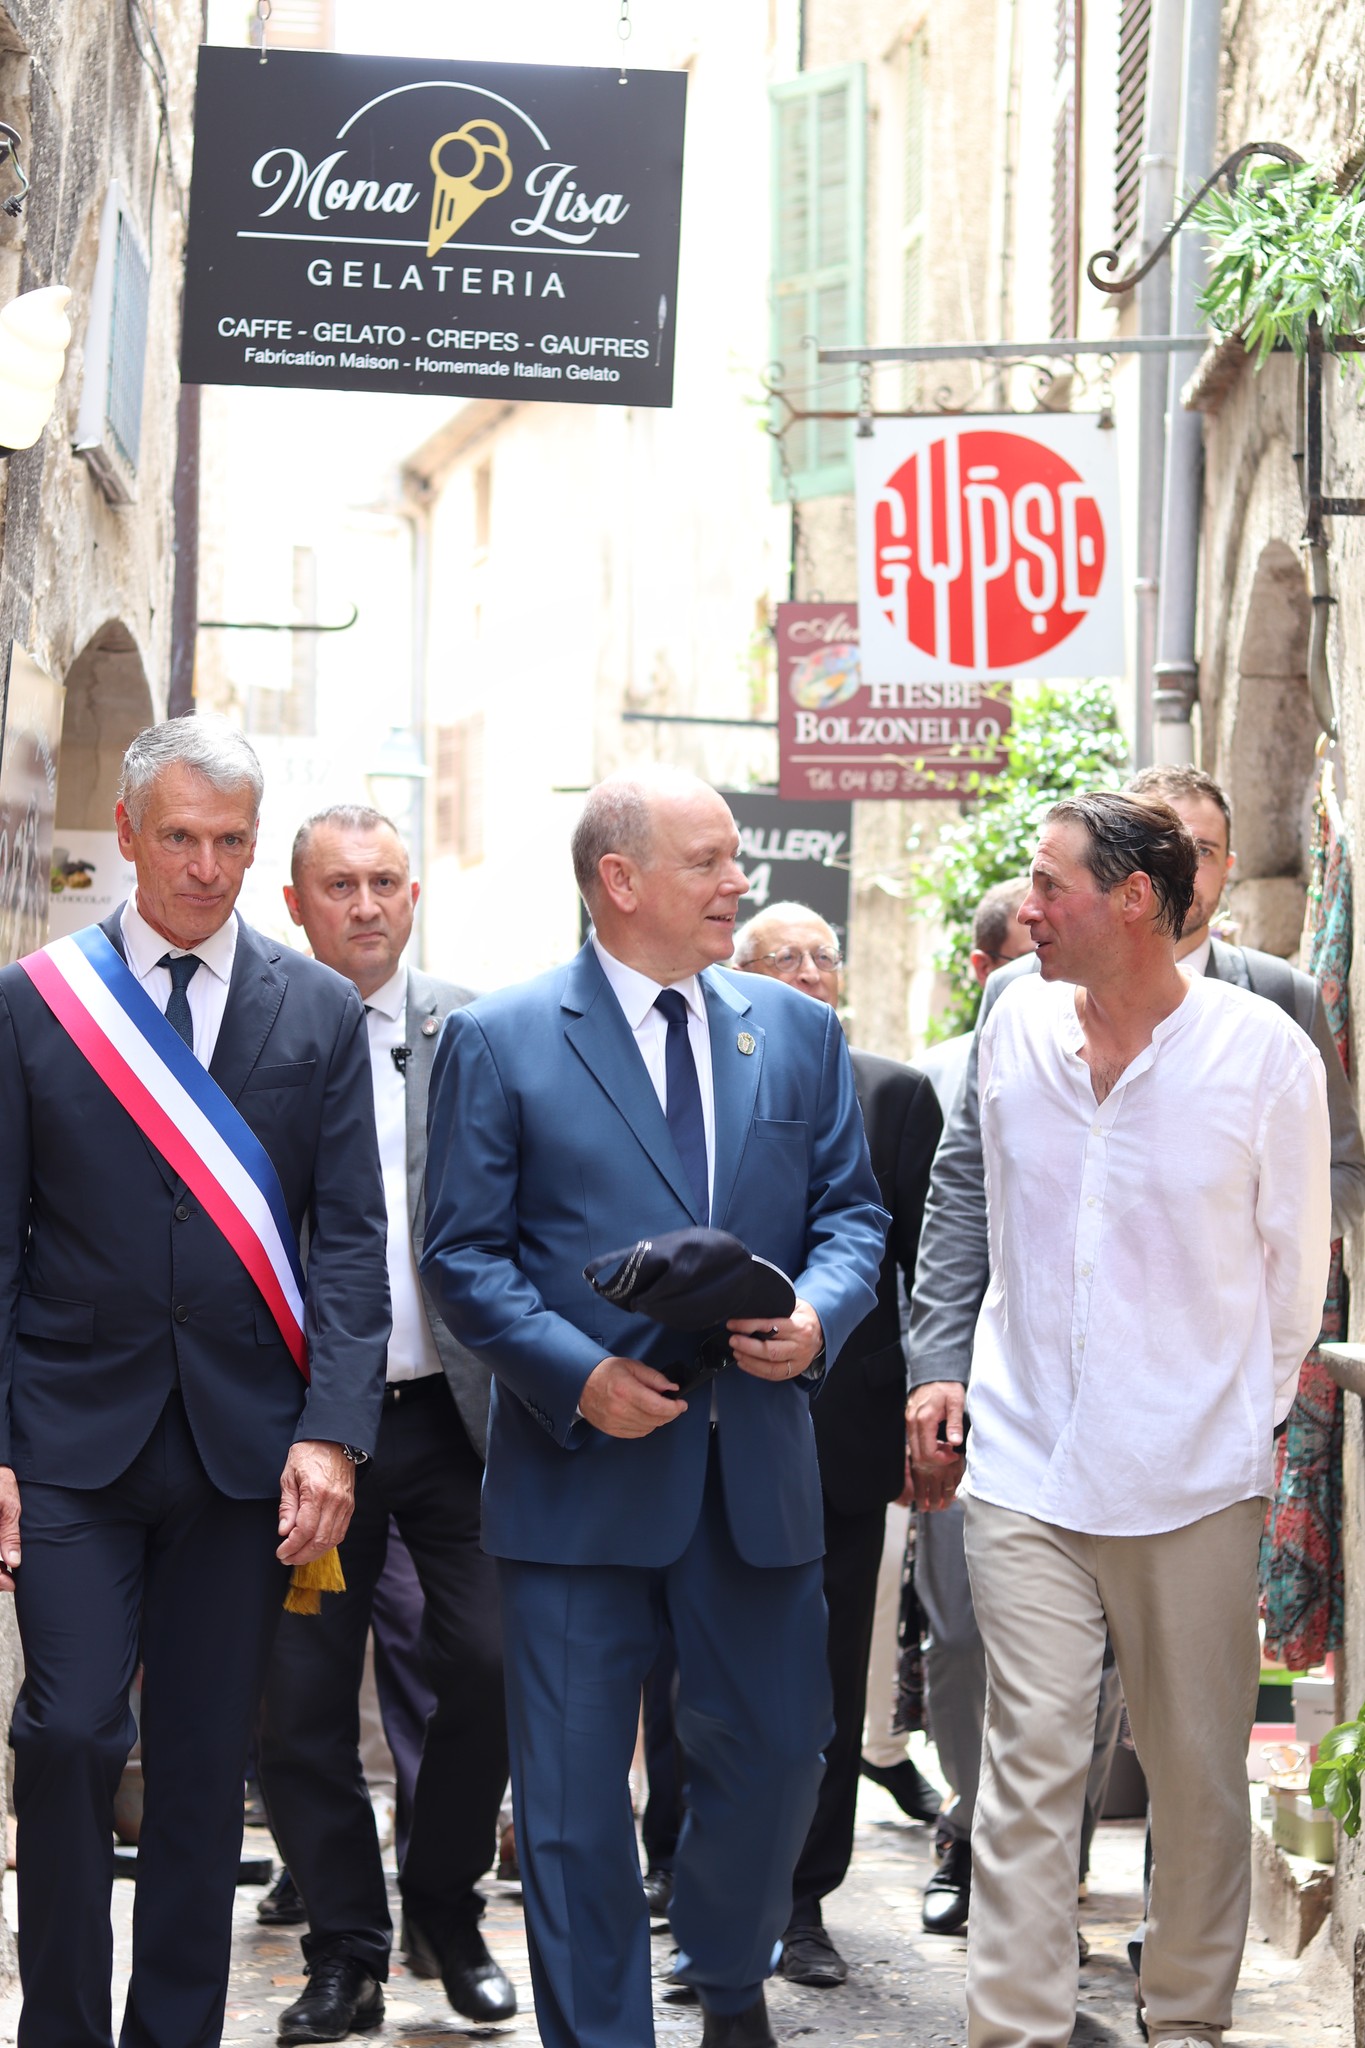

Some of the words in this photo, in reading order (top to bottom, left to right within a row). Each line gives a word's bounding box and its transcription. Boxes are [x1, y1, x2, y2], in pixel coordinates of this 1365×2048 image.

[251, 148, 420, 221] Mona
[510, 163, 630, 244] Lisa
[307, 259, 566, 298] GELATERIA
[217, 317, 292, 341] CAFFE
[313, 322, 406, 346] GELATO
[426, 328, 519, 352] CREPES
[540, 335, 650, 359] GAUFRES
[244, 347, 335, 368] Fabrication
[340, 353, 399, 371] Maison
[415, 357, 510, 377] Homemade
[514, 360, 562, 379] Italian
[566, 363, 620, 382] Gelato
[795, 711, 1001, 745] BOLZONELLO
[734, 822, 847, 861] ALLERY
